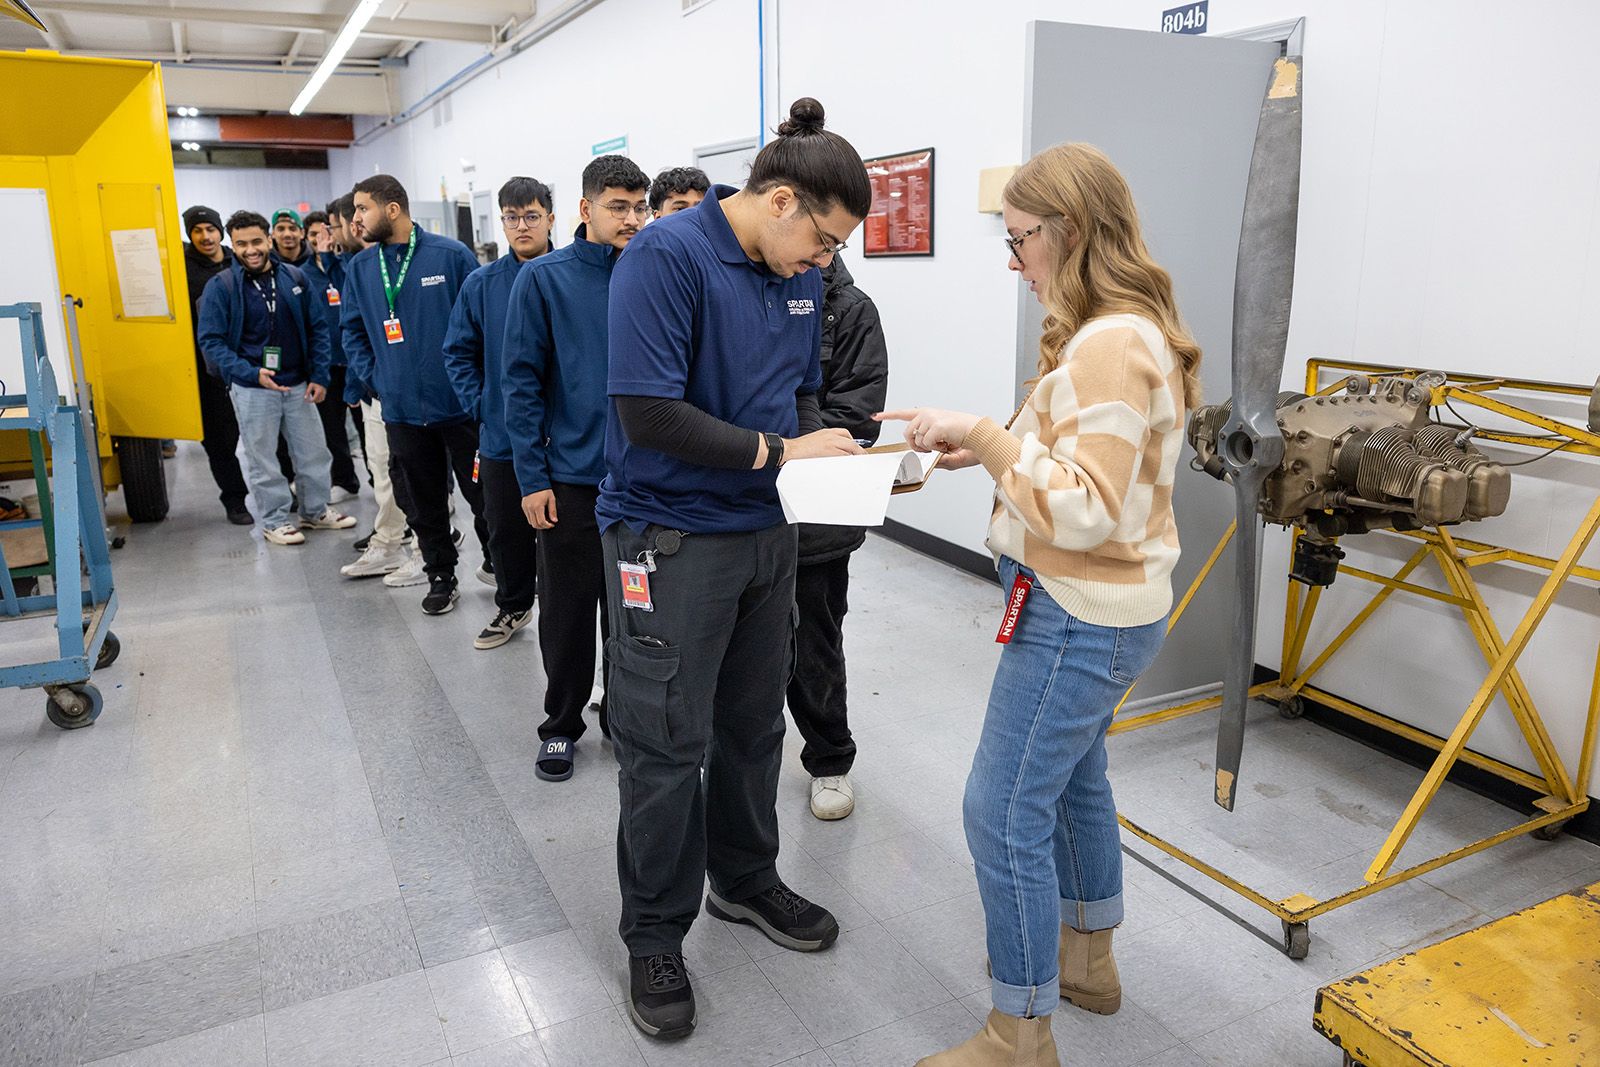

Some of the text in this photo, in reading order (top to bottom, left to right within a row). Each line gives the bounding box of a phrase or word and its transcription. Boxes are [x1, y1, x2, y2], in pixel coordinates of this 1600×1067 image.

[1163, 6, 1206, 33] 804b
[787, 299, 814, 308] SPARTAN
[1003, 587, 1025, 636] SPARTAN
[547, 742, 567, 753] GYM
